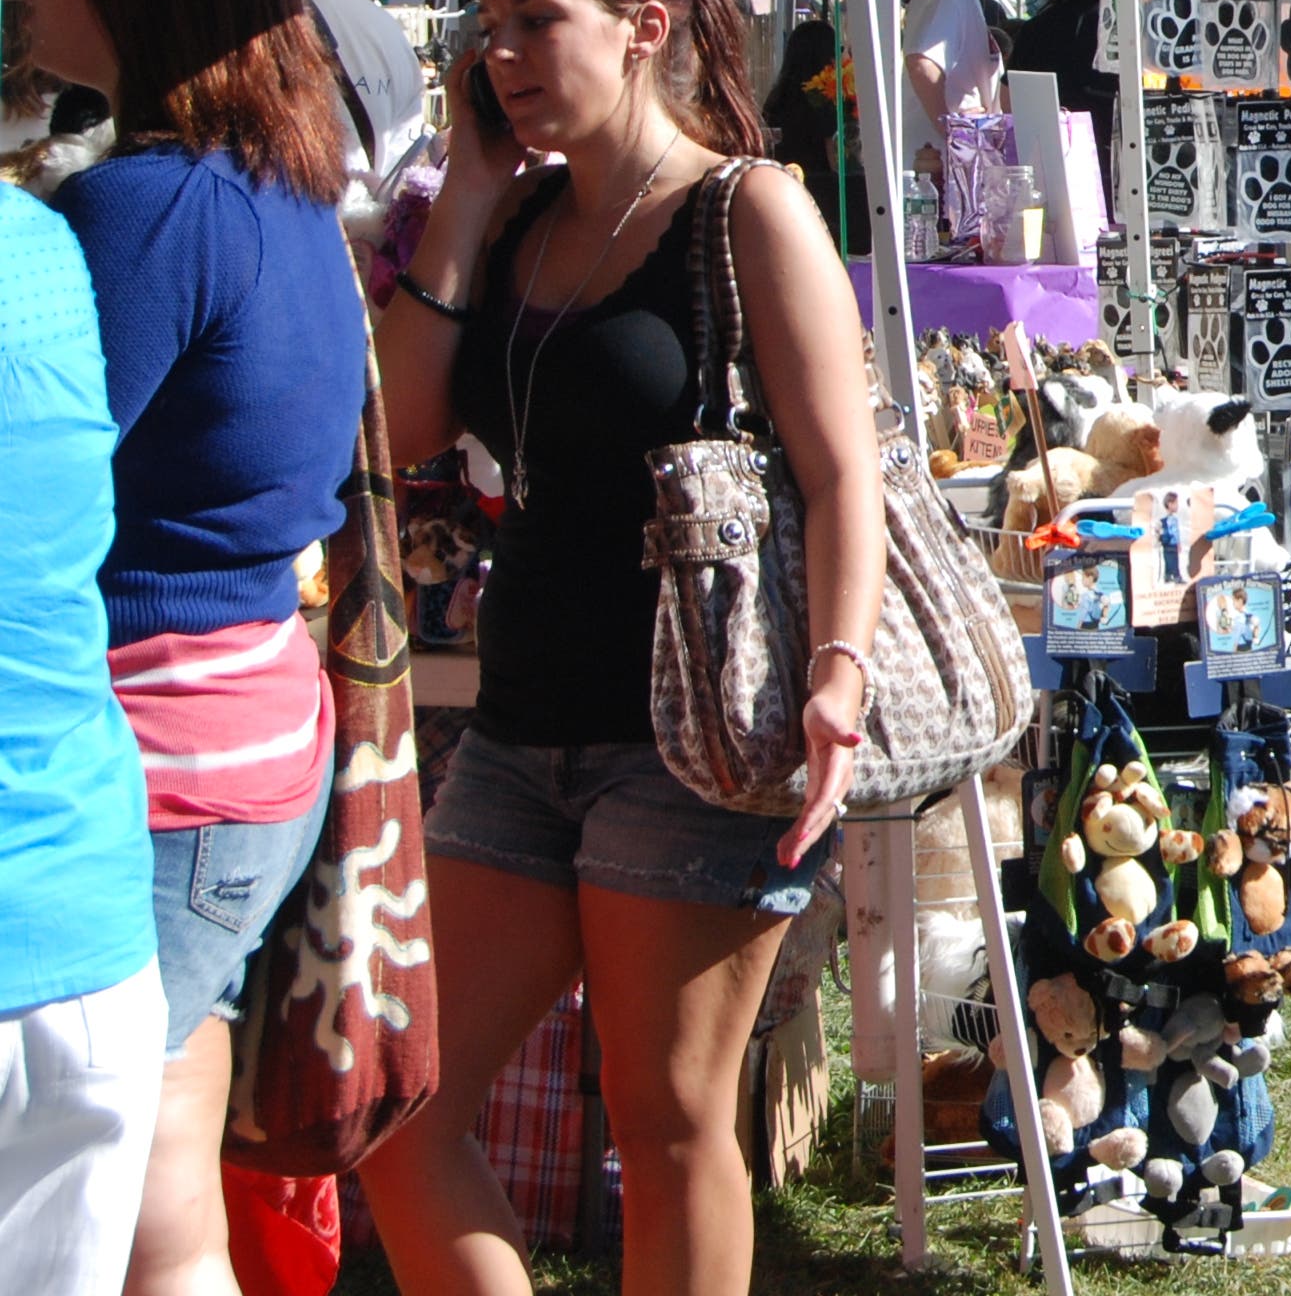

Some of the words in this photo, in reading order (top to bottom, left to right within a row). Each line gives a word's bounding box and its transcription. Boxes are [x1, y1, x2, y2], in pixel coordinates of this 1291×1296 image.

[1146, 105, 1167, 116] netic
[1241, 110, 1279, 123] Magnetic
[1248, 278, 1287, 292] Magnetic
